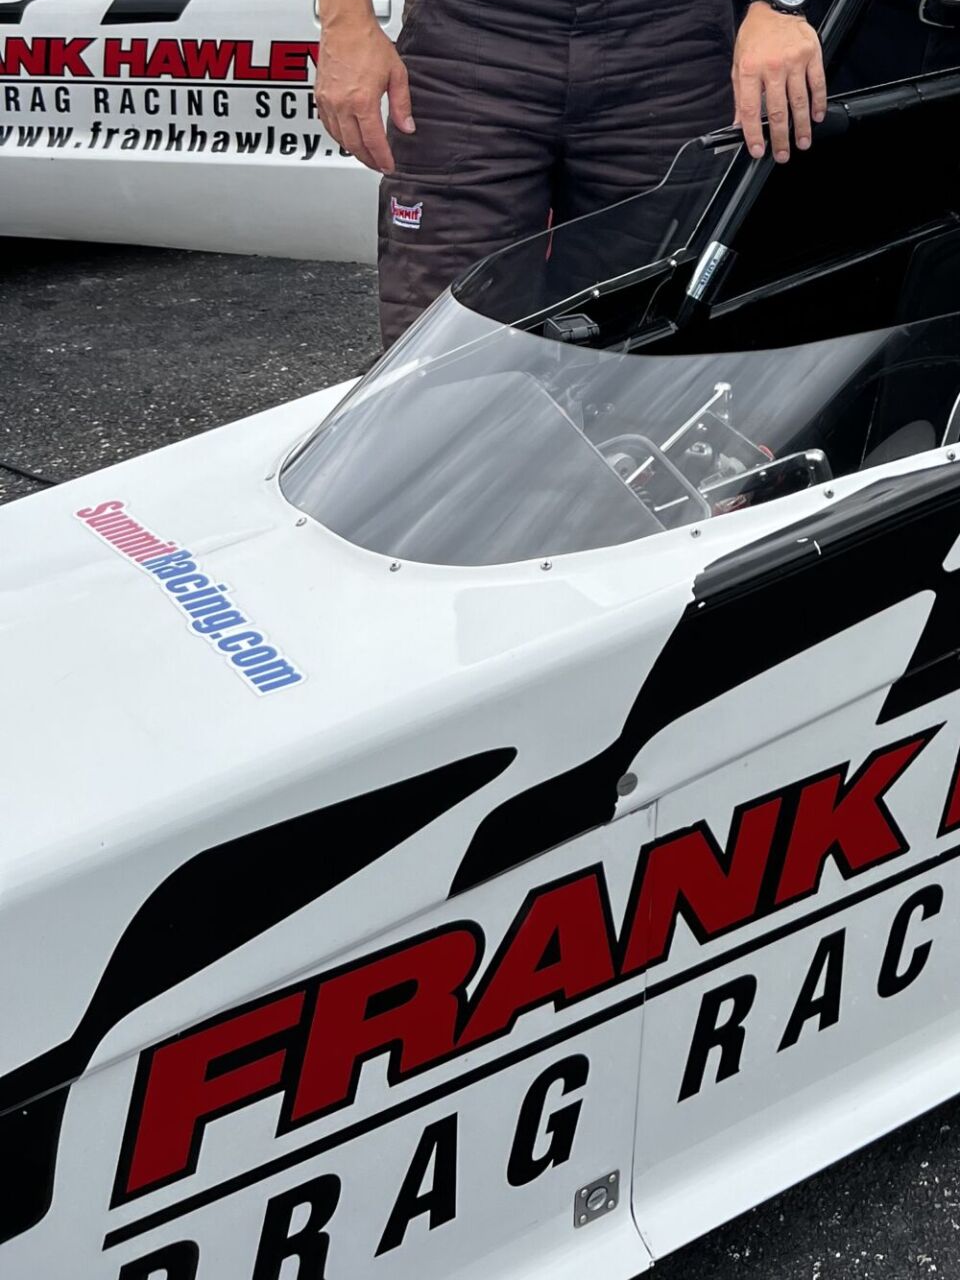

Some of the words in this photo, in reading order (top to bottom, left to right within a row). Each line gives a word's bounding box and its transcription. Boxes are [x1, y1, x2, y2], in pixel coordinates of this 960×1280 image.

[94, 88, 230, 118] RACING
[255, 90, 320, 119] SCH
[76, 500, 302, 693] SummitRacing.com
[109, 721, 946, 1210] FRANK
